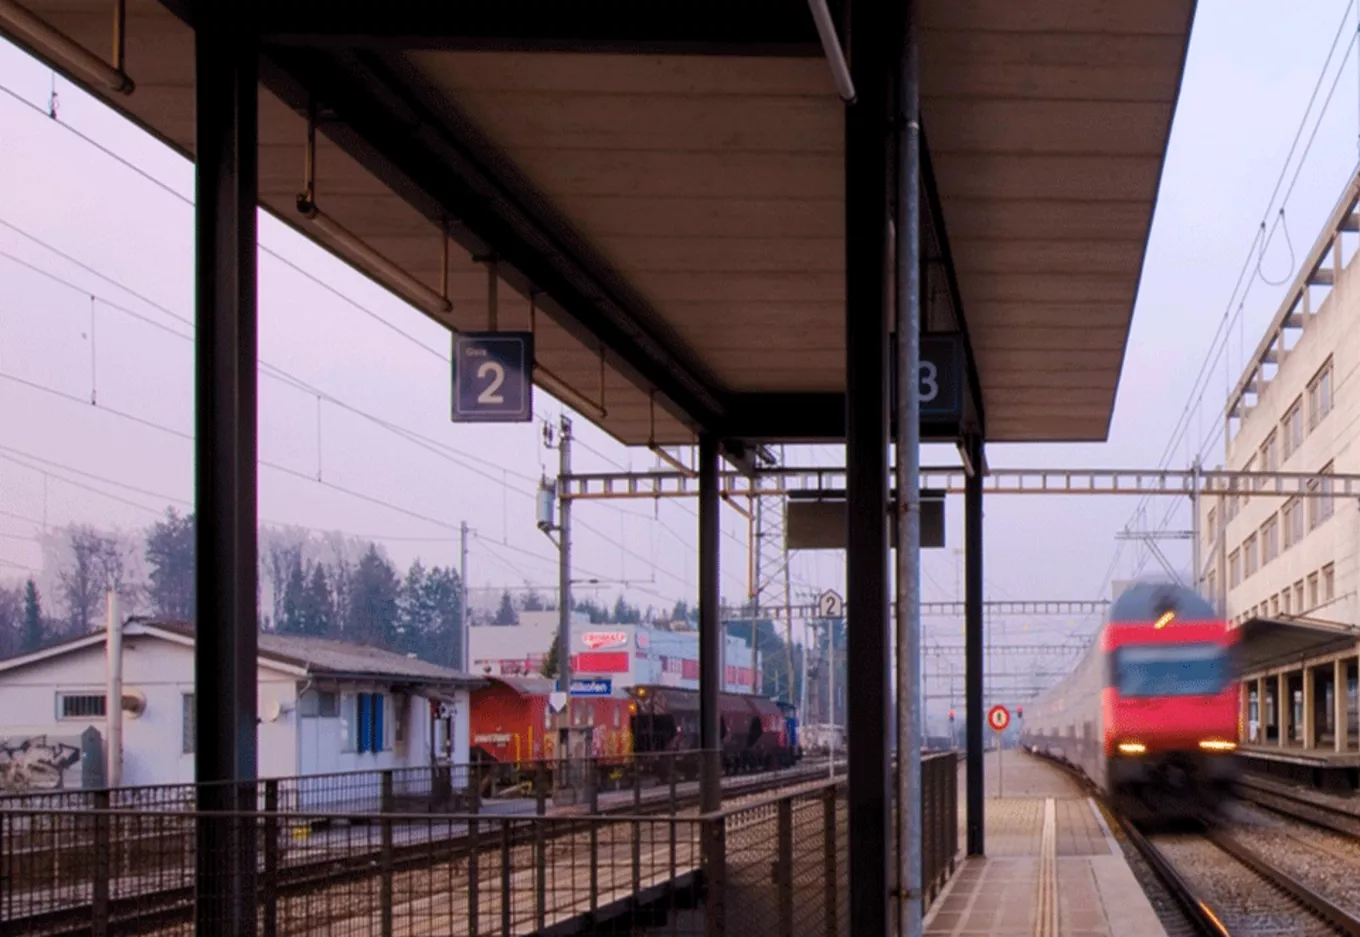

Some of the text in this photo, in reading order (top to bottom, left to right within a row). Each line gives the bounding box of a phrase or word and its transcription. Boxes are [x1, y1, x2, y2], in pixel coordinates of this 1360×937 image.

[477, 361, 504, 404] 2
[918, 359, 939, 402] 3
[826, 596, 836, 615] 2
